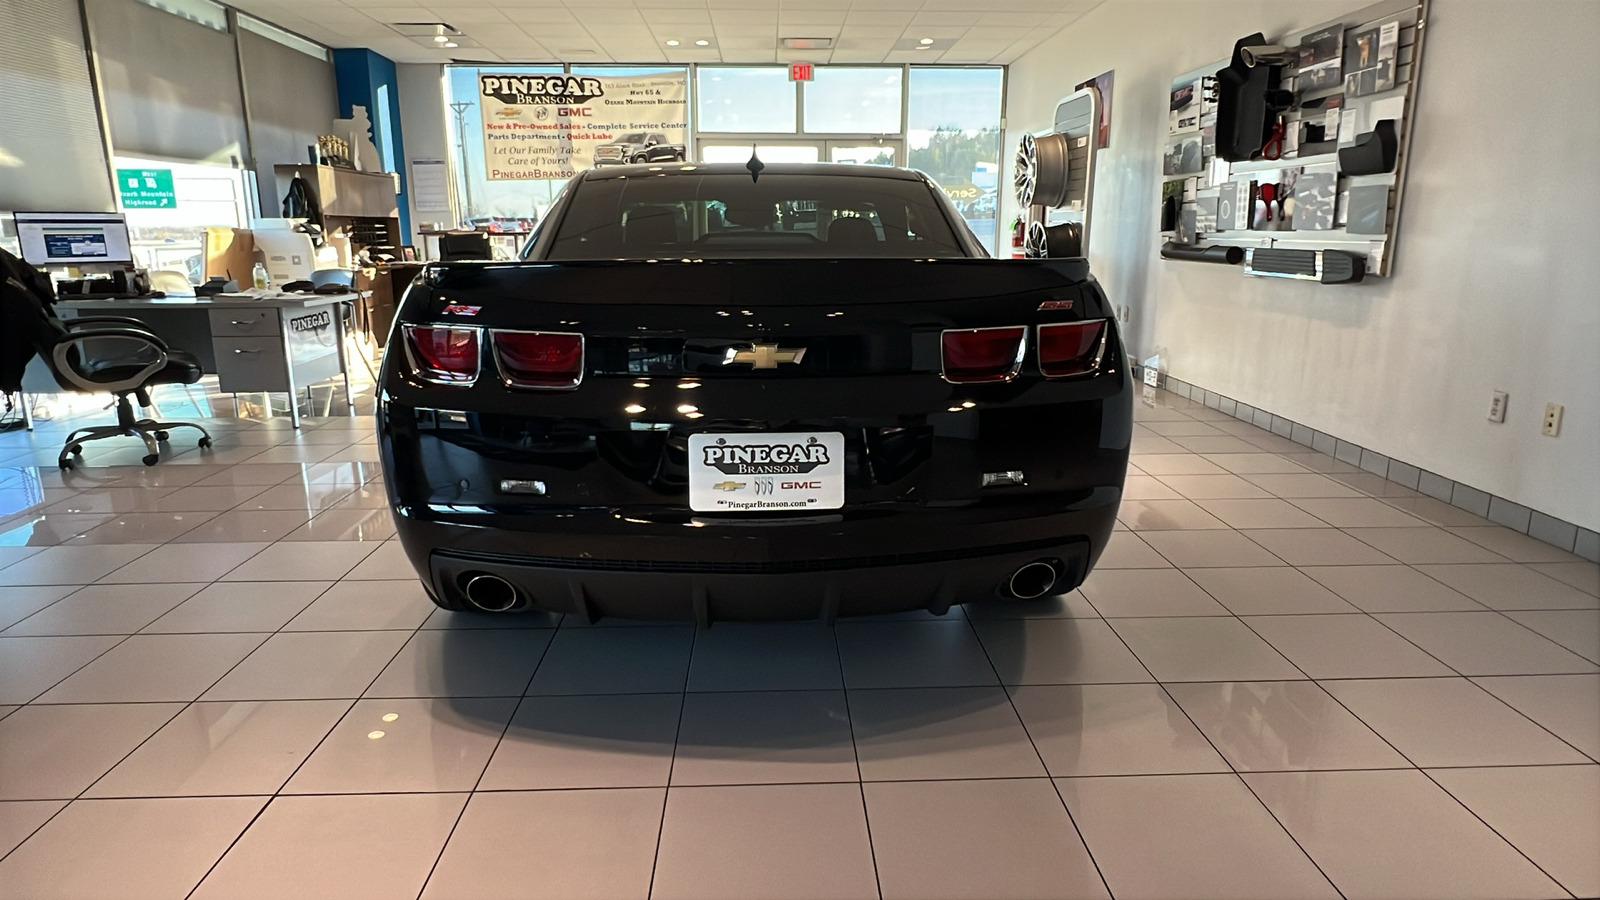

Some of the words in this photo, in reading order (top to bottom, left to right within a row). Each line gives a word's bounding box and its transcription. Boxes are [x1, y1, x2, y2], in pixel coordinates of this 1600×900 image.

[792, 64, 811, 80] EXIT
[482, 77, 602, 97] PINEGAR
[517, 94, 575, 104] BRANSON
[557, 108, 592, 117] GMC
[587, 123, 627, 131] Complete
[511, 133, 560, 141] Department
[566, 133, 590, 141] Quick
[528, 146, 557, 156] Family
[560, 146, 582, 154] Take
[508, 157, 529, 165] Care
[530, 157, 540, 166] of
[542, 157, 569, 165] Yours!
[291, 311, 330, 332] PINEGAR
[704, 445, 829, 466] PINEGAR
[738, 464, 800, 474] BRANSON
[780, 481, 822, 490] GMC
[728, 499, 807, 509] PinegarBranson.com
